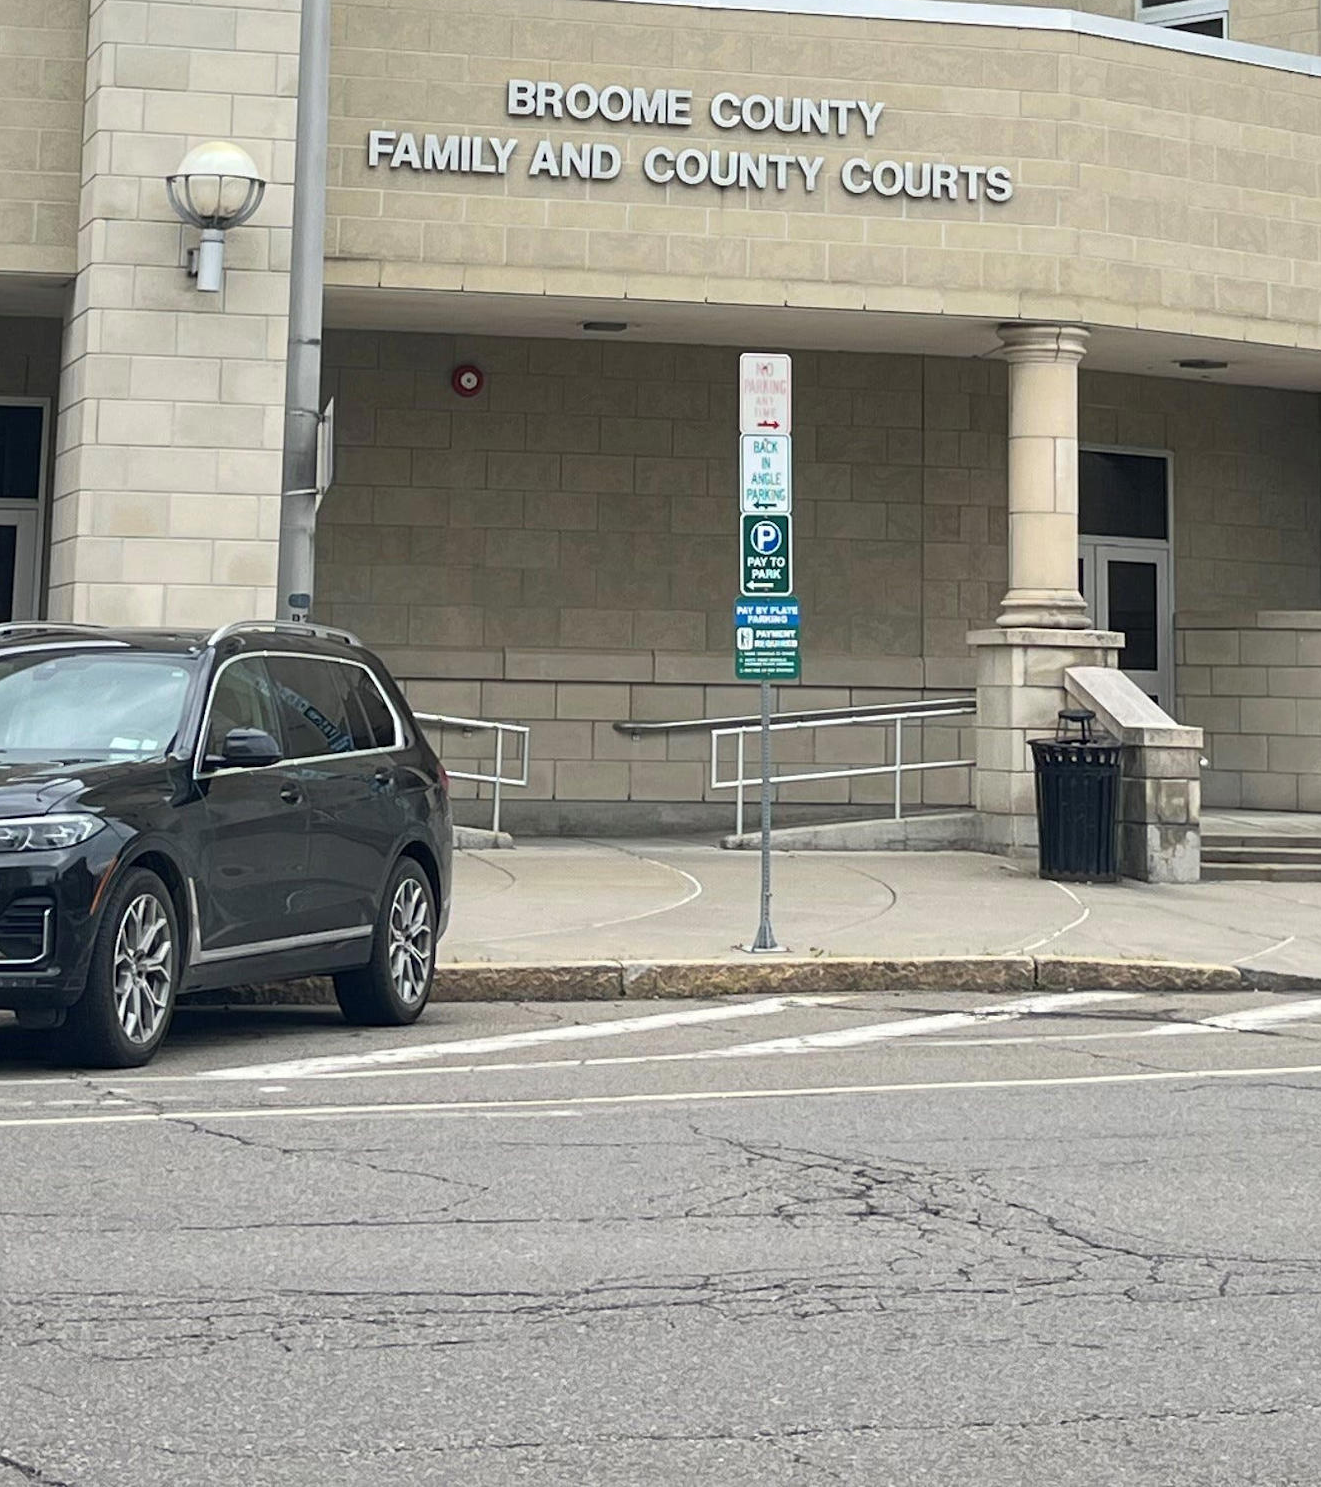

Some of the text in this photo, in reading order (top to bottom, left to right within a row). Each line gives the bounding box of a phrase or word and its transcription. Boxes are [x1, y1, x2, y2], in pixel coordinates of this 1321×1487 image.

[506, 78, 885, 137] BROOME COUNTY
[367, 129, 1015, 203] FAMILY AND COUNTY COURTS
[756, 362, 774, 377] NO
[744, 379, 787, 395] PARKING
[753, 440, 778, 454] BACK
[761, 457, 771, 469] IN
[751, 472, 782, 486] ANGLE
[746, 488, 786, 502] PARKING
[757, 525, 776, 550] P
[747, 556, 786, 568] PAY TO
[751, 569, 782, 580] PARK
[736, 606, 753, 615] PAY
[747, 615, 788, 624] PARKING
